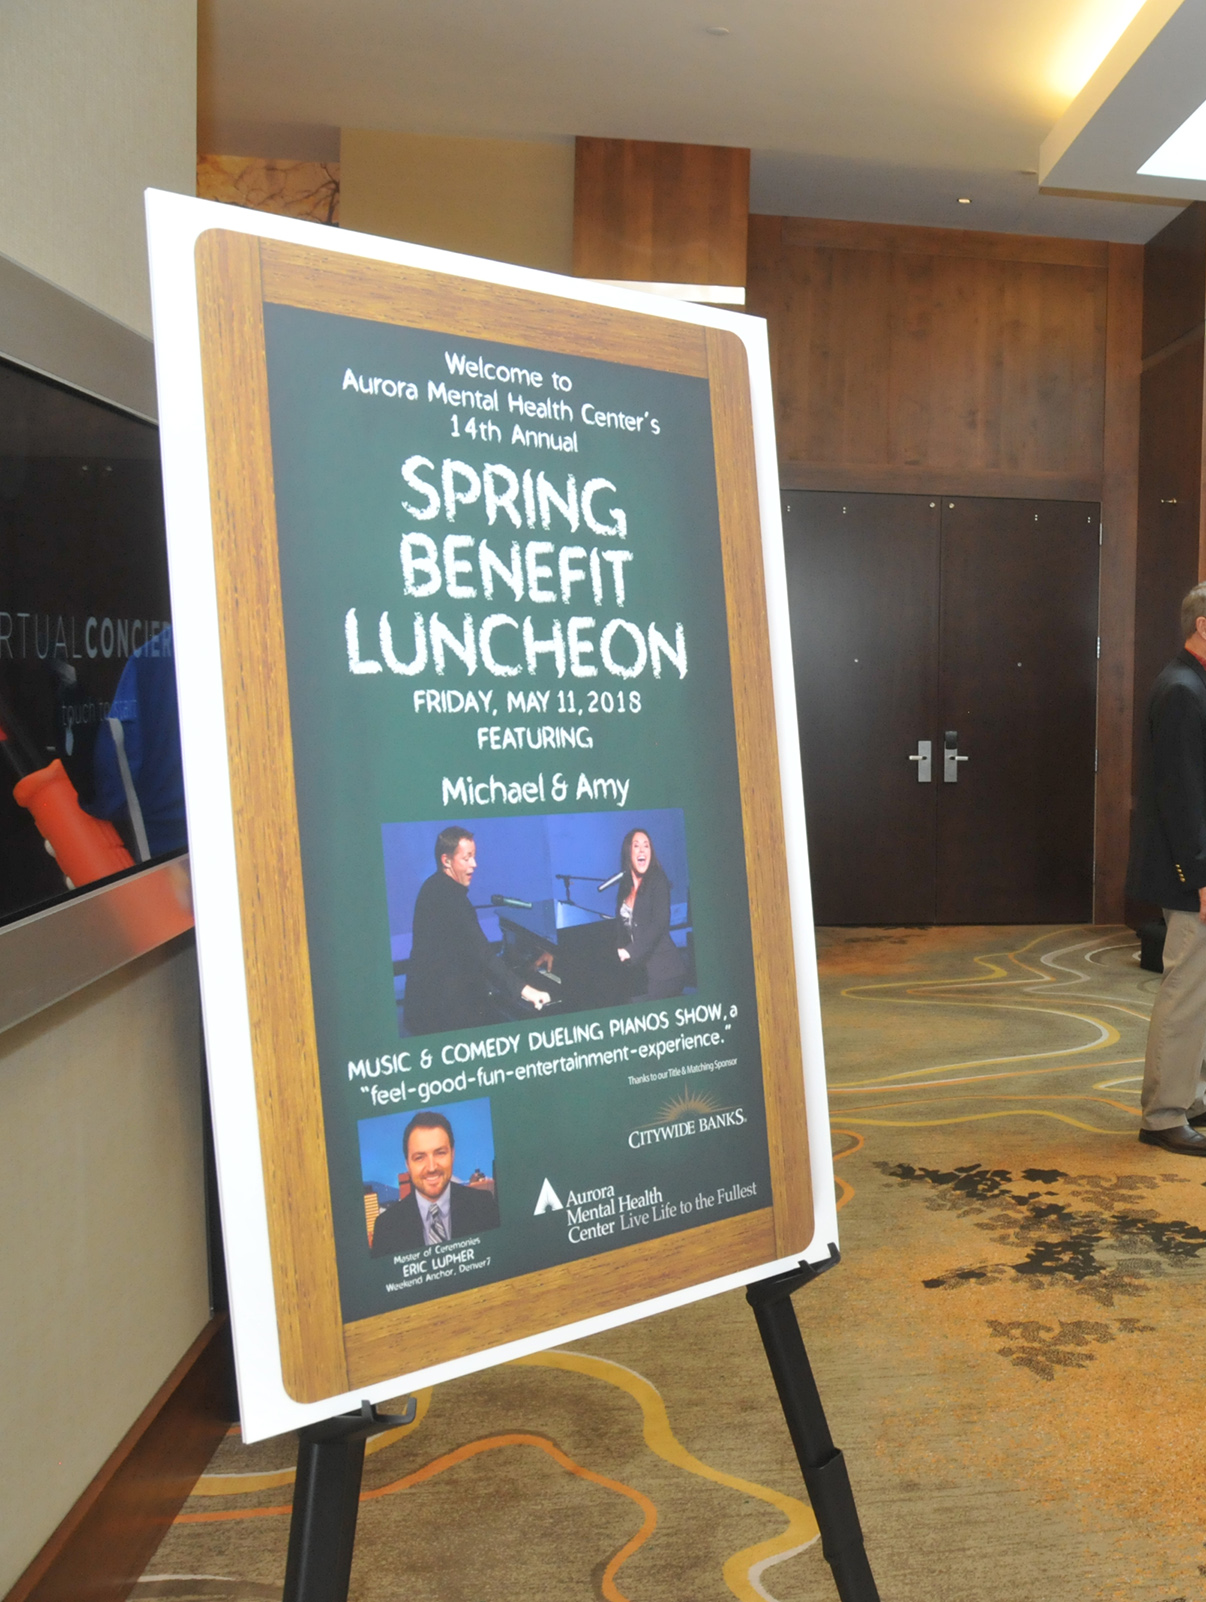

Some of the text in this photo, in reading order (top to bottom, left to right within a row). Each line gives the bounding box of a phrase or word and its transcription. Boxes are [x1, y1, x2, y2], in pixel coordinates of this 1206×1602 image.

[445, 351, 573, 392] Welcome to
[342, 368, 661, 434] Aurora Mental Health Center's
[450, 415, 578, 453] 14th Annual
[401, 454, 627, 540] SPRING
[400, 532, 634, 608] BENEFIT
[345, 608, 688, 679] LUNCHEON
[413, 690, 642, 716] FRIDAY, MAY 11, 2018
[477, 726, 593, 750] FEATURING
[442, 773, 630, 807] Michael & Amy
[347, 1003, 738, 1081] MUSIC & COMEDY DUELING PIANOS SHOW, a
[628, 1058, 738, 1086] Thanks to our Title & Matching Sponsor
[628, 1121, 695, 1149] CITYWIDE
[566, 1185, 615, 1207] Aurora
[567, 1186, 663, 1226] Mental Health
[568, 1182, 757, 1244] Center Live Life to the Fullest
[393, 1237, 481, 1265] Master of Ceremonies
[402, 1248, 475, 1277] ERIC LUPHER
[385, 1257, 491, 1292] Weekend Anchor, Denver7
